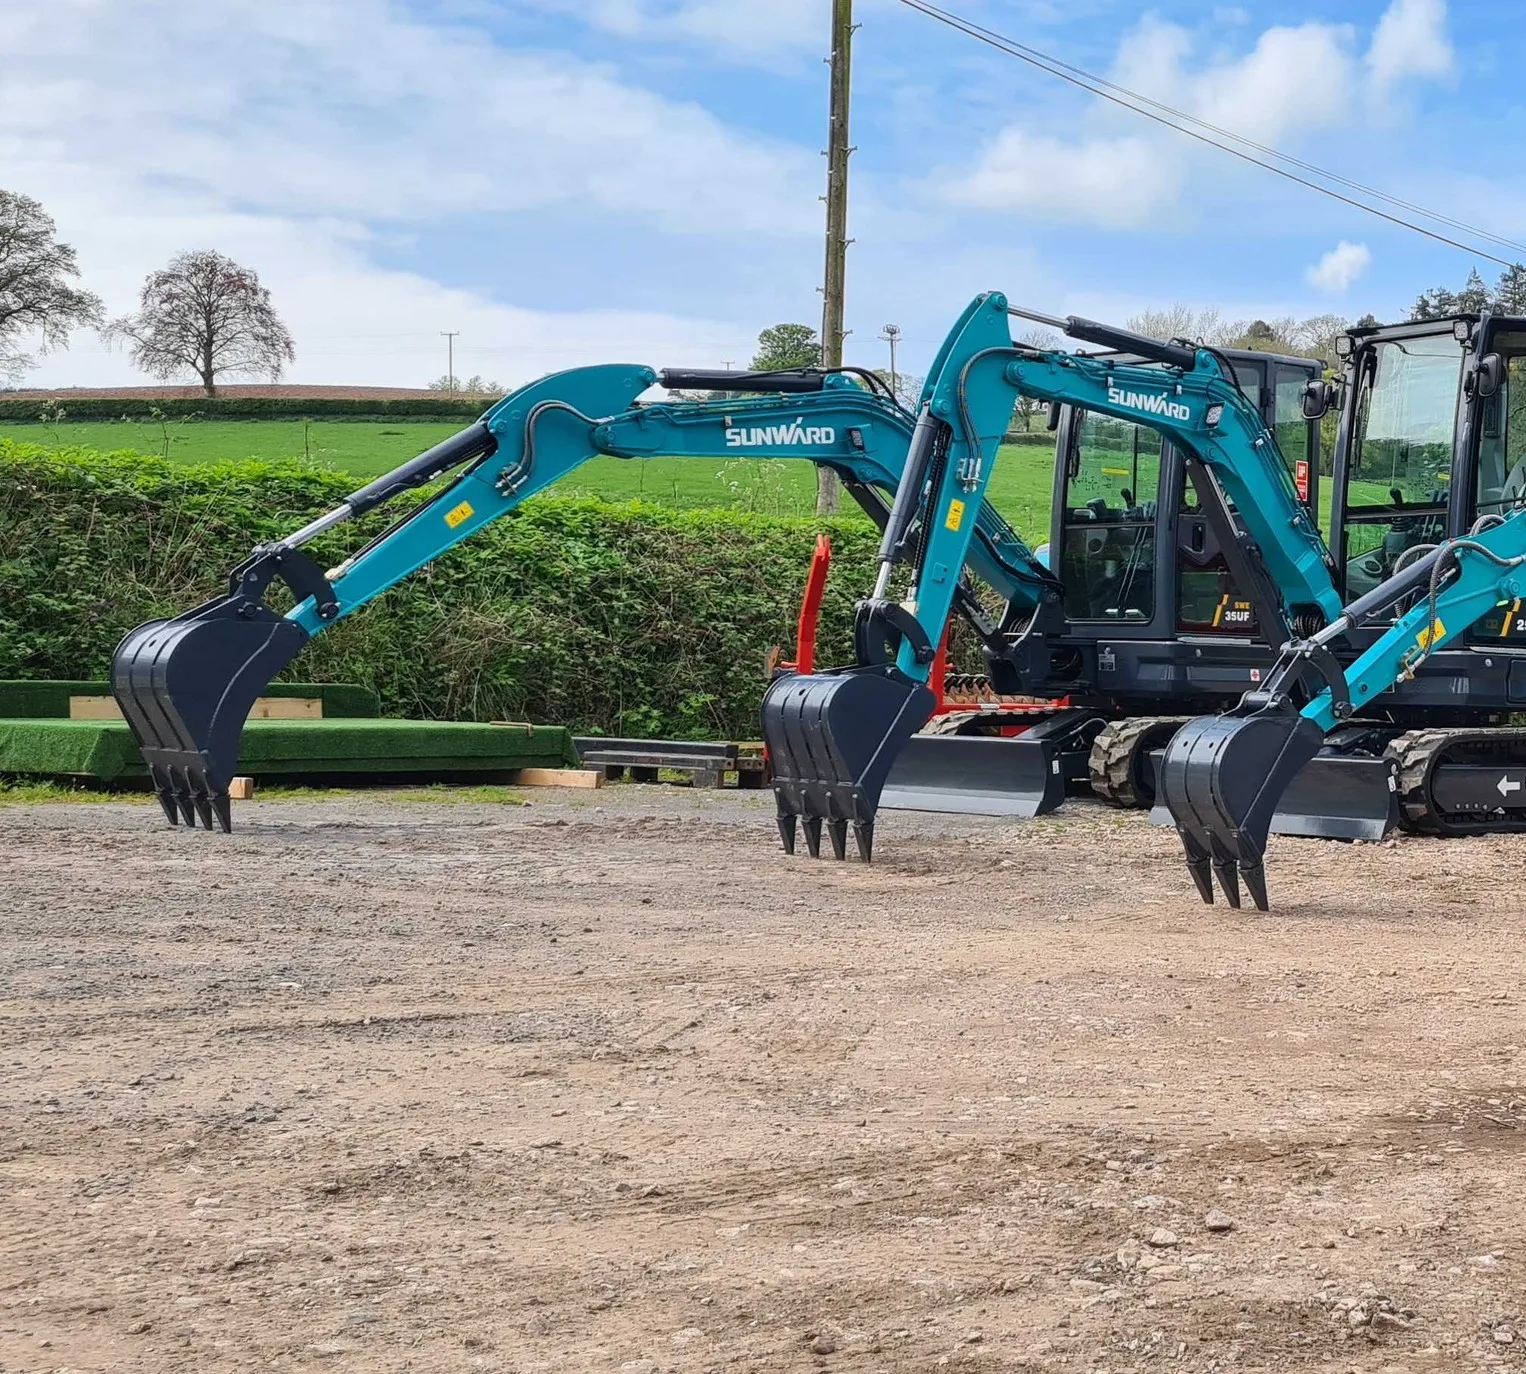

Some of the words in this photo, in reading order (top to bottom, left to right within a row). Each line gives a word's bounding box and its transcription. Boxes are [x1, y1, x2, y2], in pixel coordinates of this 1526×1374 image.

[1108, 387, 1190, 420] SUNWARD
[725, 416, 835, 446] SUNWARD
[1224, 610, 1250, 621] 35UF
